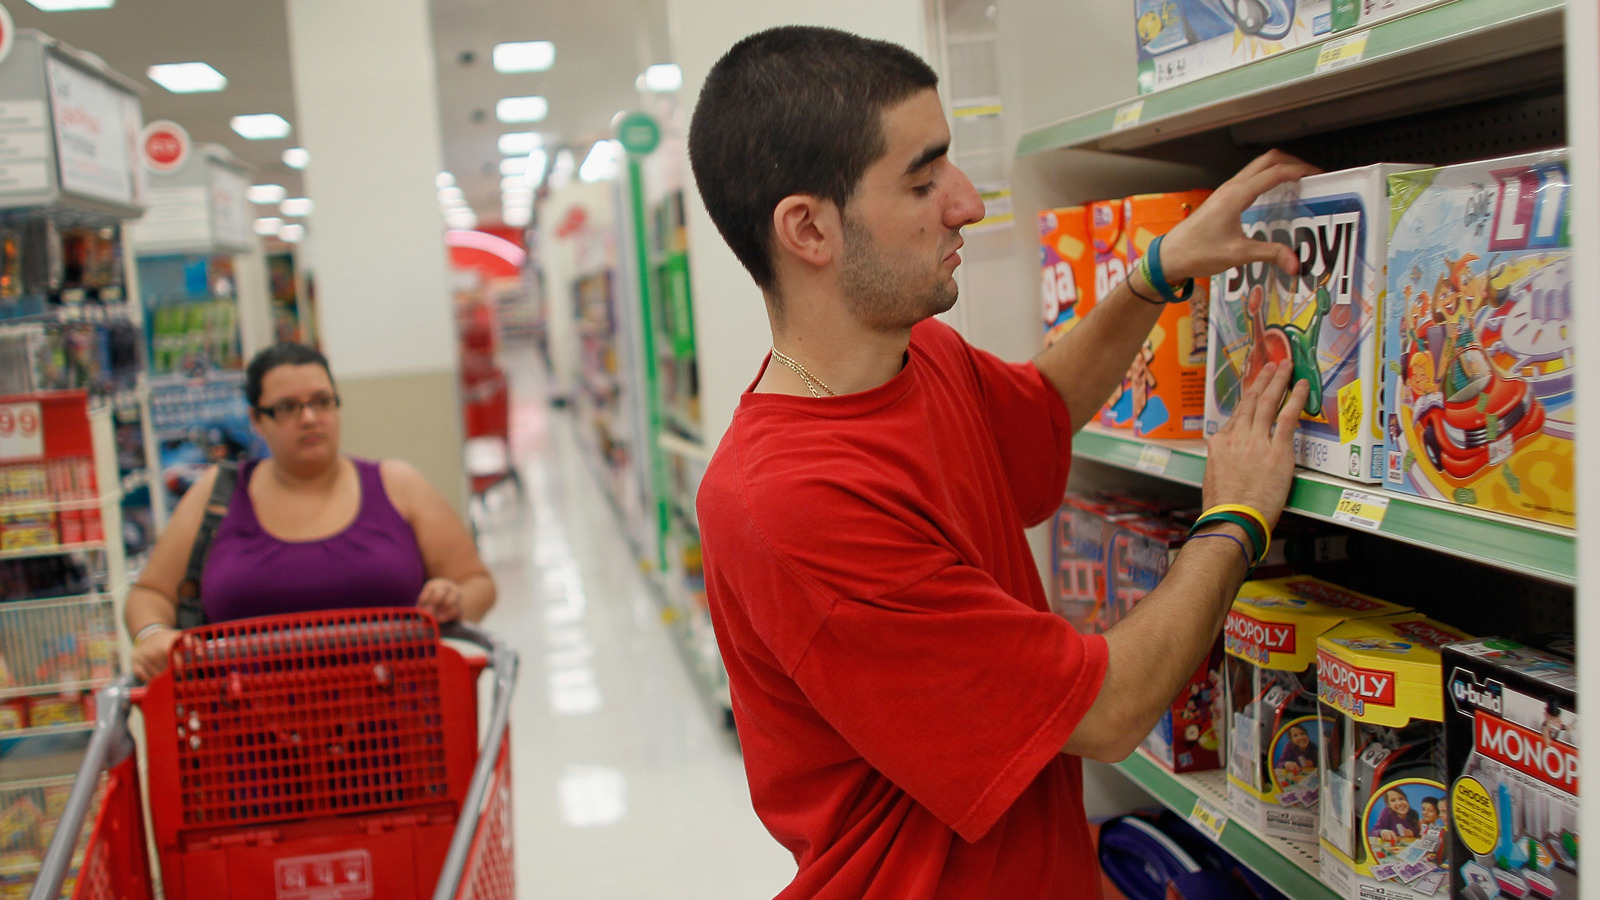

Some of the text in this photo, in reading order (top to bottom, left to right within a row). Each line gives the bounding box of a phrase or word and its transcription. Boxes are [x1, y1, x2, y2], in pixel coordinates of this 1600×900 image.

[1494, 168, 1574, 242] LI
[1042, 260, 1079, 327] ga
[1294, 436, 1328, 467] evenge
[1338, 500, 1362, 515] 17.49
[1224, 613, 1289, 648] ONOPOLY
[1317, 653, 1388, 698] ONOPOLY
[1453, 680, 1501, 714] u-build
[1481, 719, 1580, 785] MONOP
[1458, 785, 1490, 808] CHOOSE
